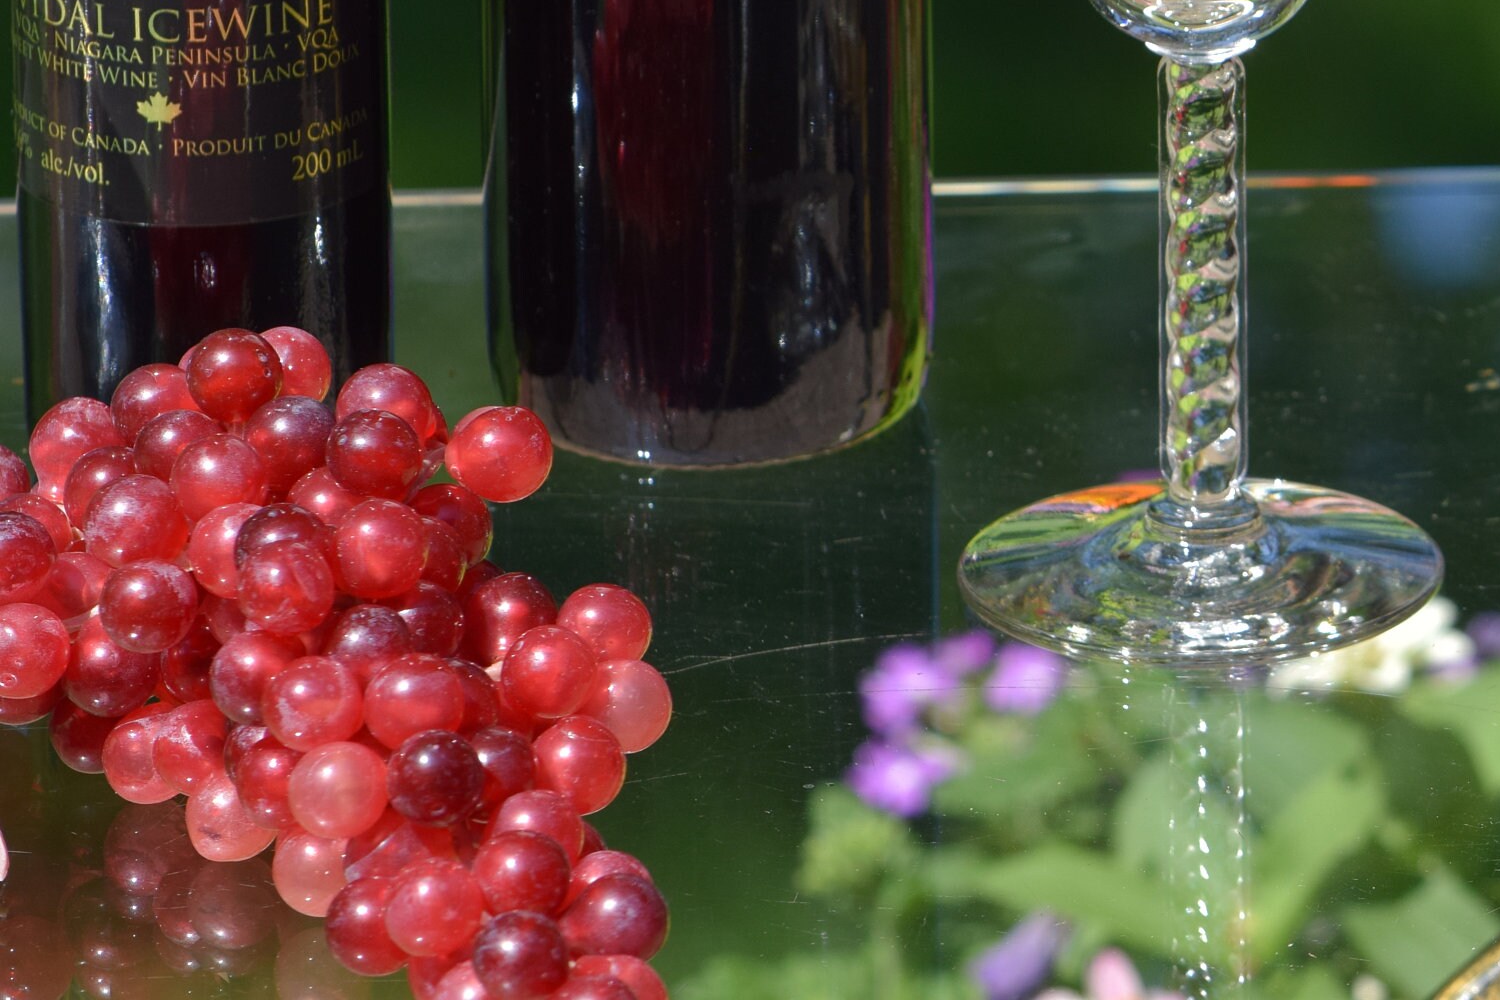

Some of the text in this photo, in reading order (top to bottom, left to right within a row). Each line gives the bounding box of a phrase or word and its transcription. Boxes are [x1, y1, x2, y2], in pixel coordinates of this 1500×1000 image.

[38, 47, 92, 82] WHITE
[99, 66, 158, 88] WINE
[183, 69, 226, 88] VIN
[237, 56, 305, 86] BLANC
[313, 41, 360, 73] DOUX
[55, 31, 143, 64] NIAGARA
[152, 43, 275, 66] PENINSULA
[298, 29, 339, 51] VQA
[49, 121, 67, 141] OF
[72, 128, 150, 155] CANADA
[173, 136, 266, 157] PRODUIT
[275, 130, 300, 150] DU
[307, 107, 368, 142] CANADA
[41, 149, 110, 185] alc./vol.
[292, 139, 363, 181] 200 mL
